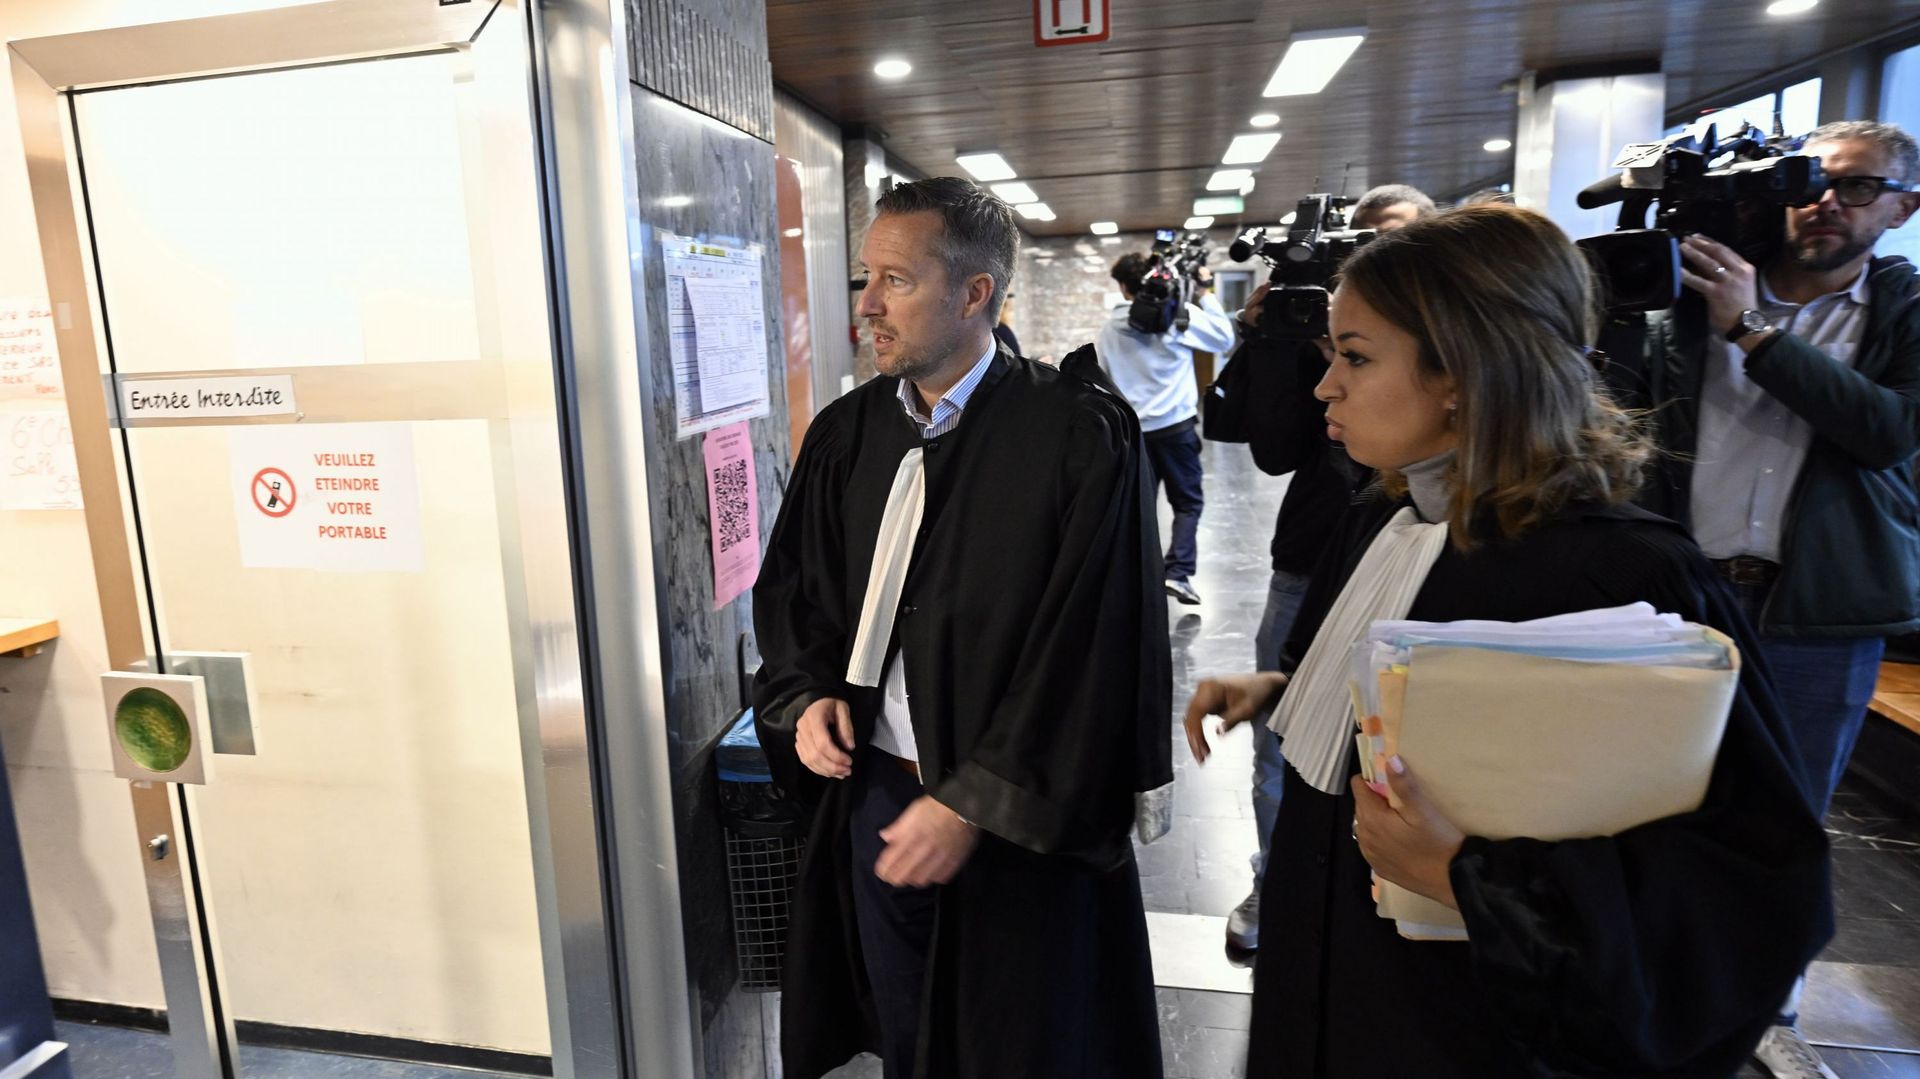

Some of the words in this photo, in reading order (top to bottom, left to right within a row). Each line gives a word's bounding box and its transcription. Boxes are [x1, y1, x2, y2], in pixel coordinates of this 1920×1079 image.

[131, 391, 190, 410] Entrée
[198, 386, 283, 408] Interdite
[314, 453, 376, 467] VEUILLEZ
[315, 477, 380, 491] ETEINDRE
[327, 502, 373, 515] VOTRE
[318, 525, 388, 540] PORTABLE
